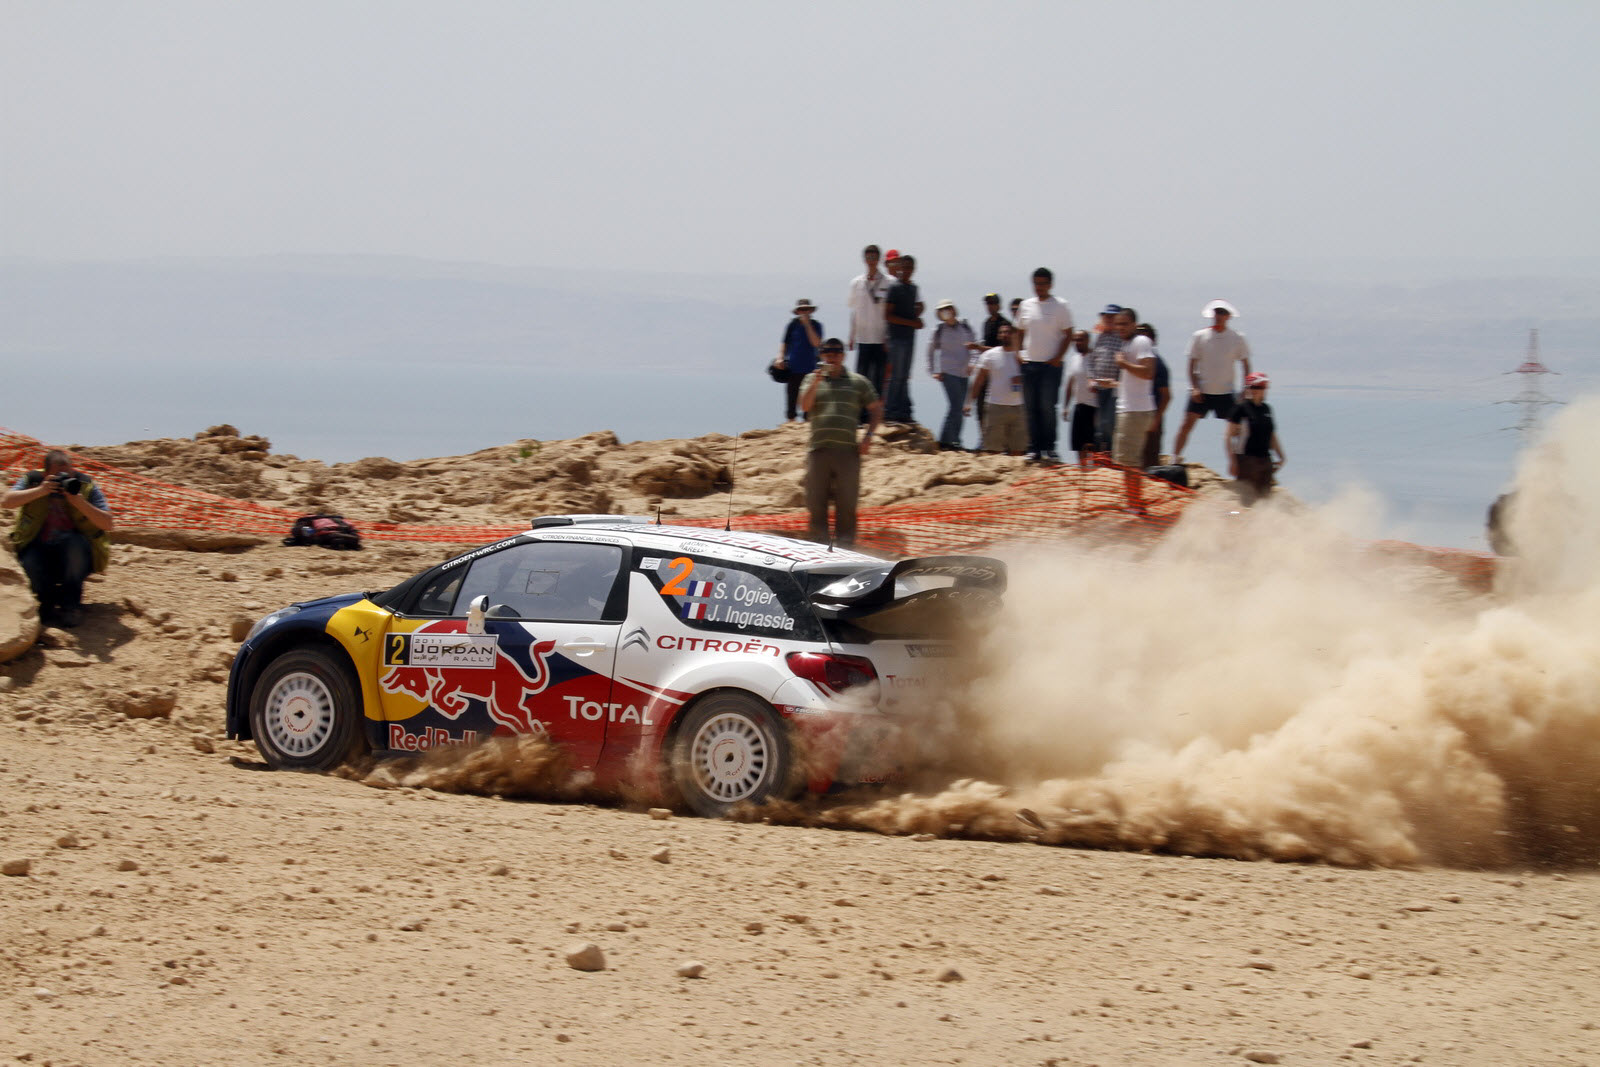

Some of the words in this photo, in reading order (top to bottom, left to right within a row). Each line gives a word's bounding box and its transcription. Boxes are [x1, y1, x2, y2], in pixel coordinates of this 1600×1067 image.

[442, 539, 516, 570] CITROEN-WRC.COM
[659, 557, 695, 596] 2
[714, 582, 728, 600] S.
[734, 585, 777, 607] Ogier
[707, 604, 720, 622] J.
[725, 606, 795, 630] Ingrassia
[391, 635, 405, 664] 2
[414, 644, 493, 655] JORDAN
[563, 695, 653, 726] TOTAL
[389, 723, 433, 753] Red
